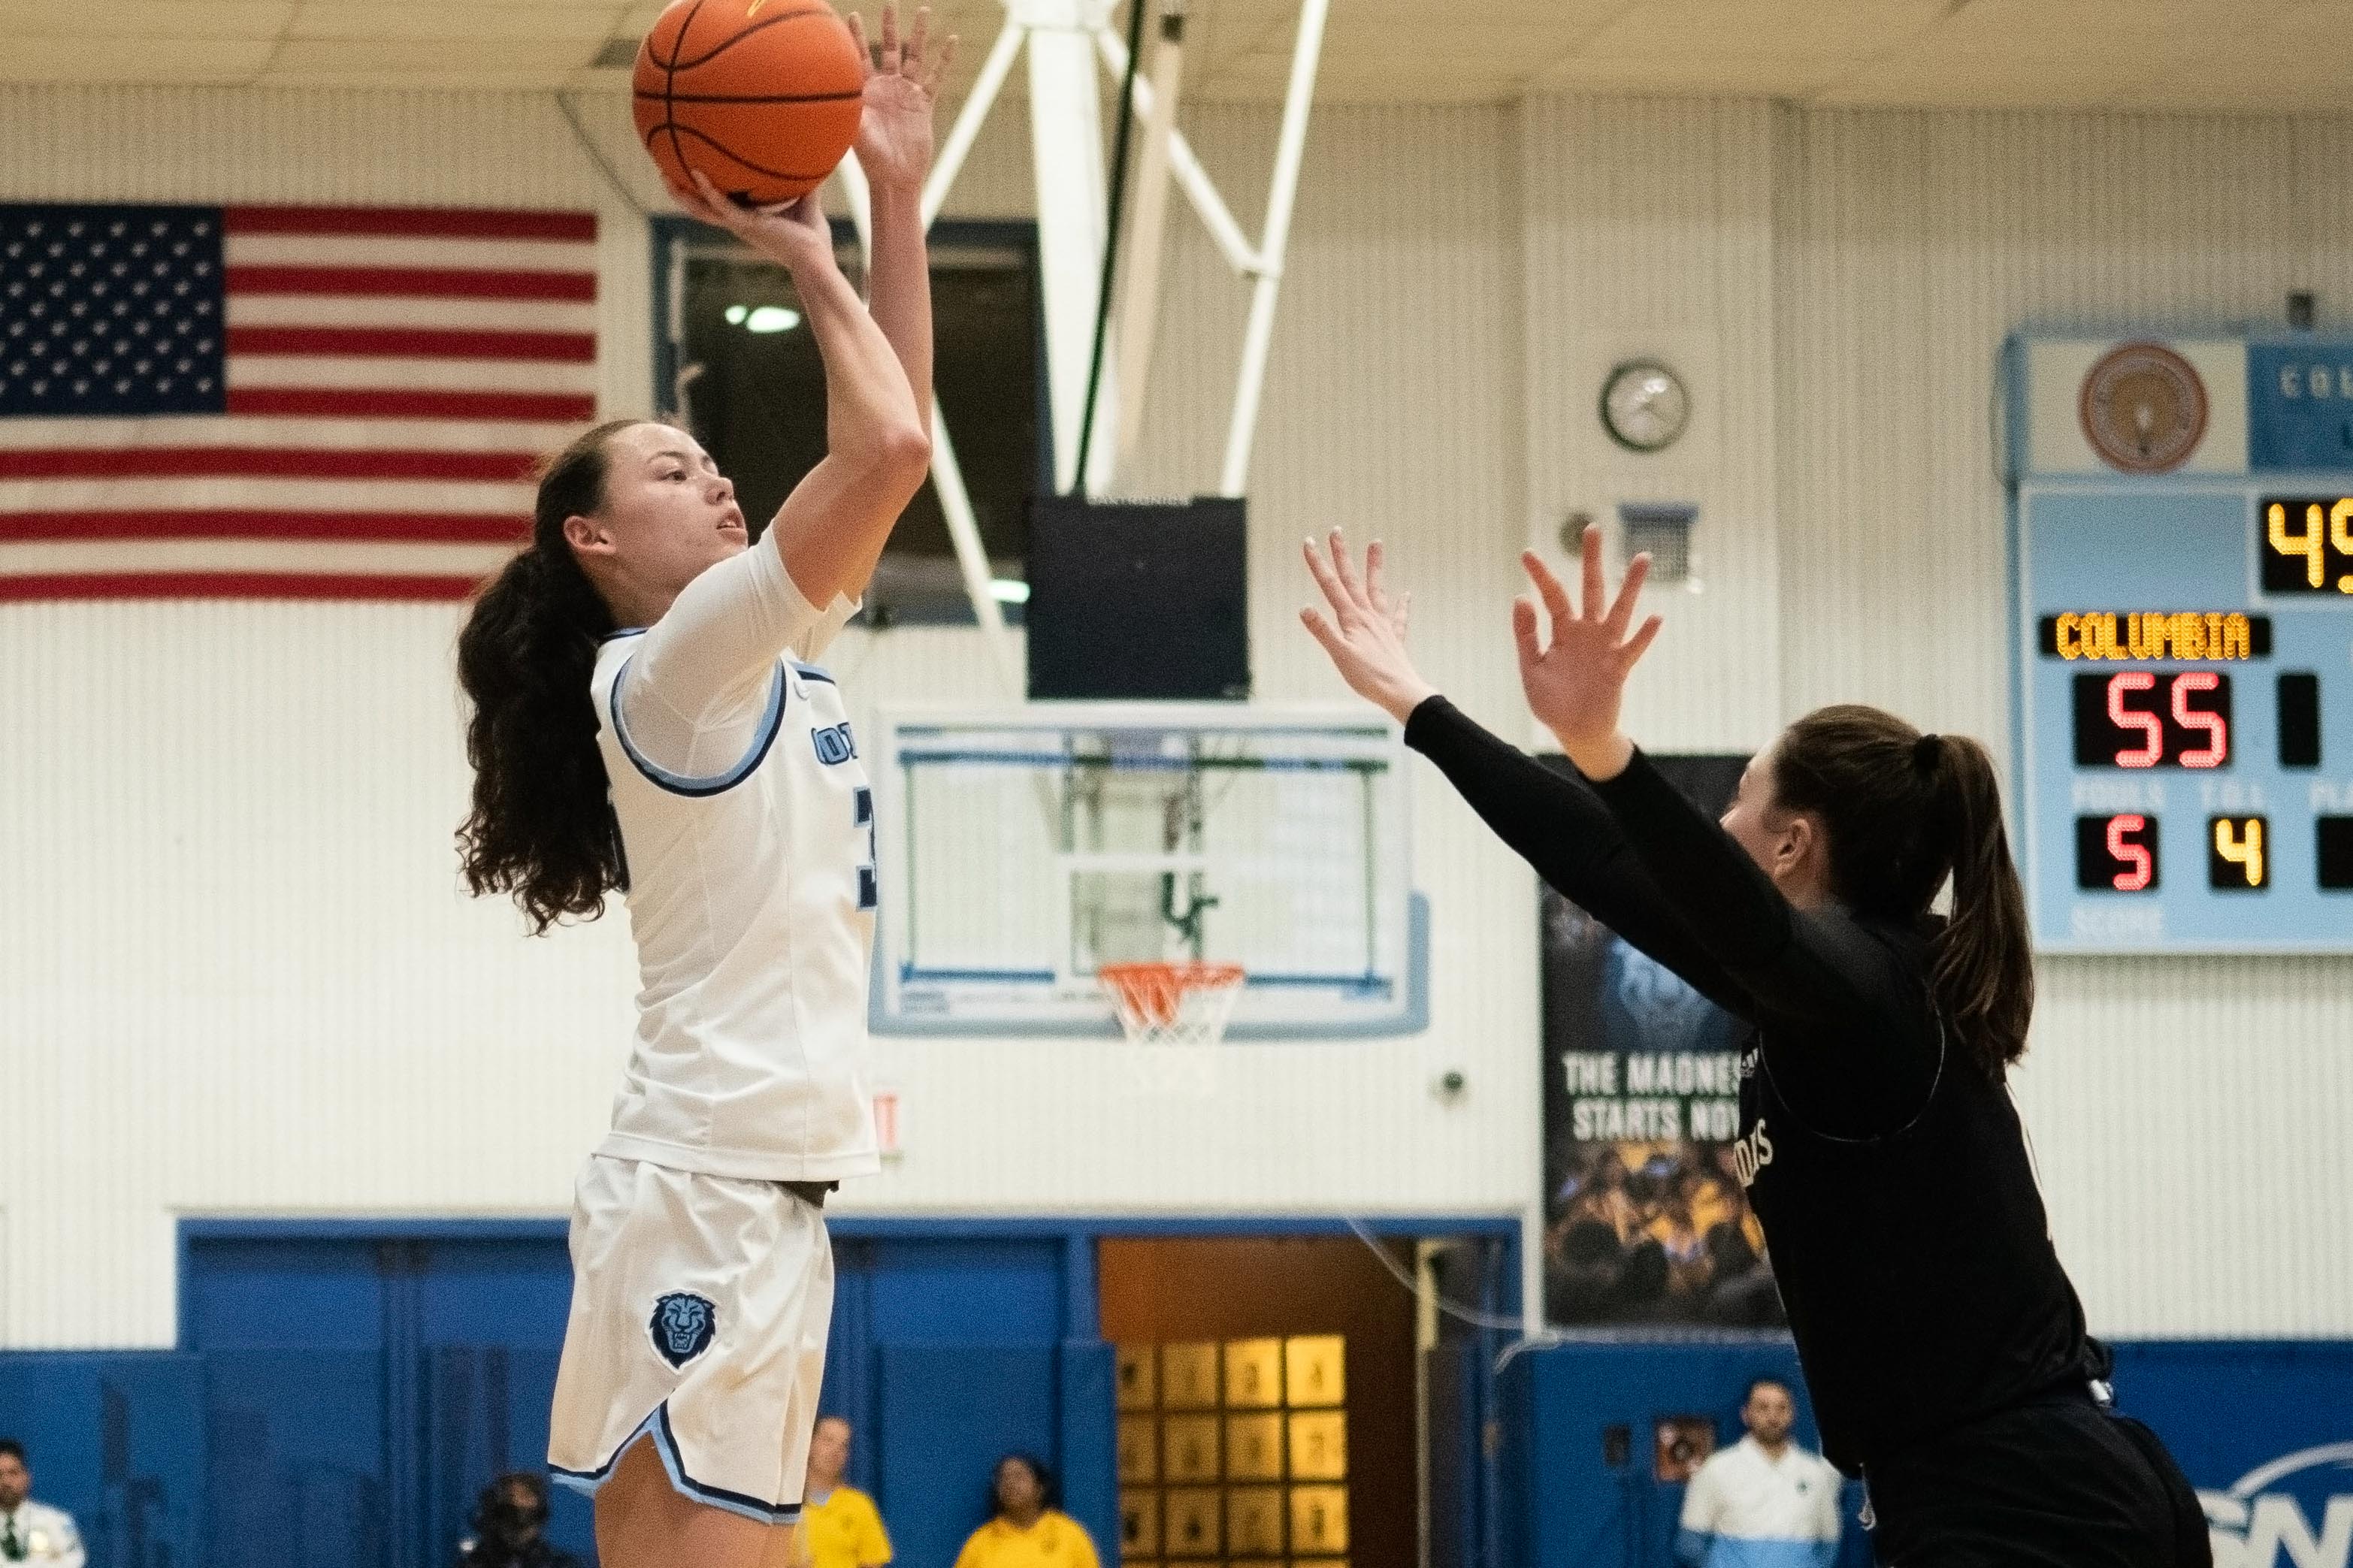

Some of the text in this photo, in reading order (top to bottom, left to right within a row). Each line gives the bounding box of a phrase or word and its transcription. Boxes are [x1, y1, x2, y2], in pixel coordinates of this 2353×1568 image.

[2056, 612, 2250, 660] COLUMBIA
[2107, 672, 2227, 768] 55
[2107, 814, 2152, 891] 5
[2215, 818, 2263, 886] 4
[1563, 1052, 1617, 1095] THE
[1573, 1099, 1682, 1141] STARTS
